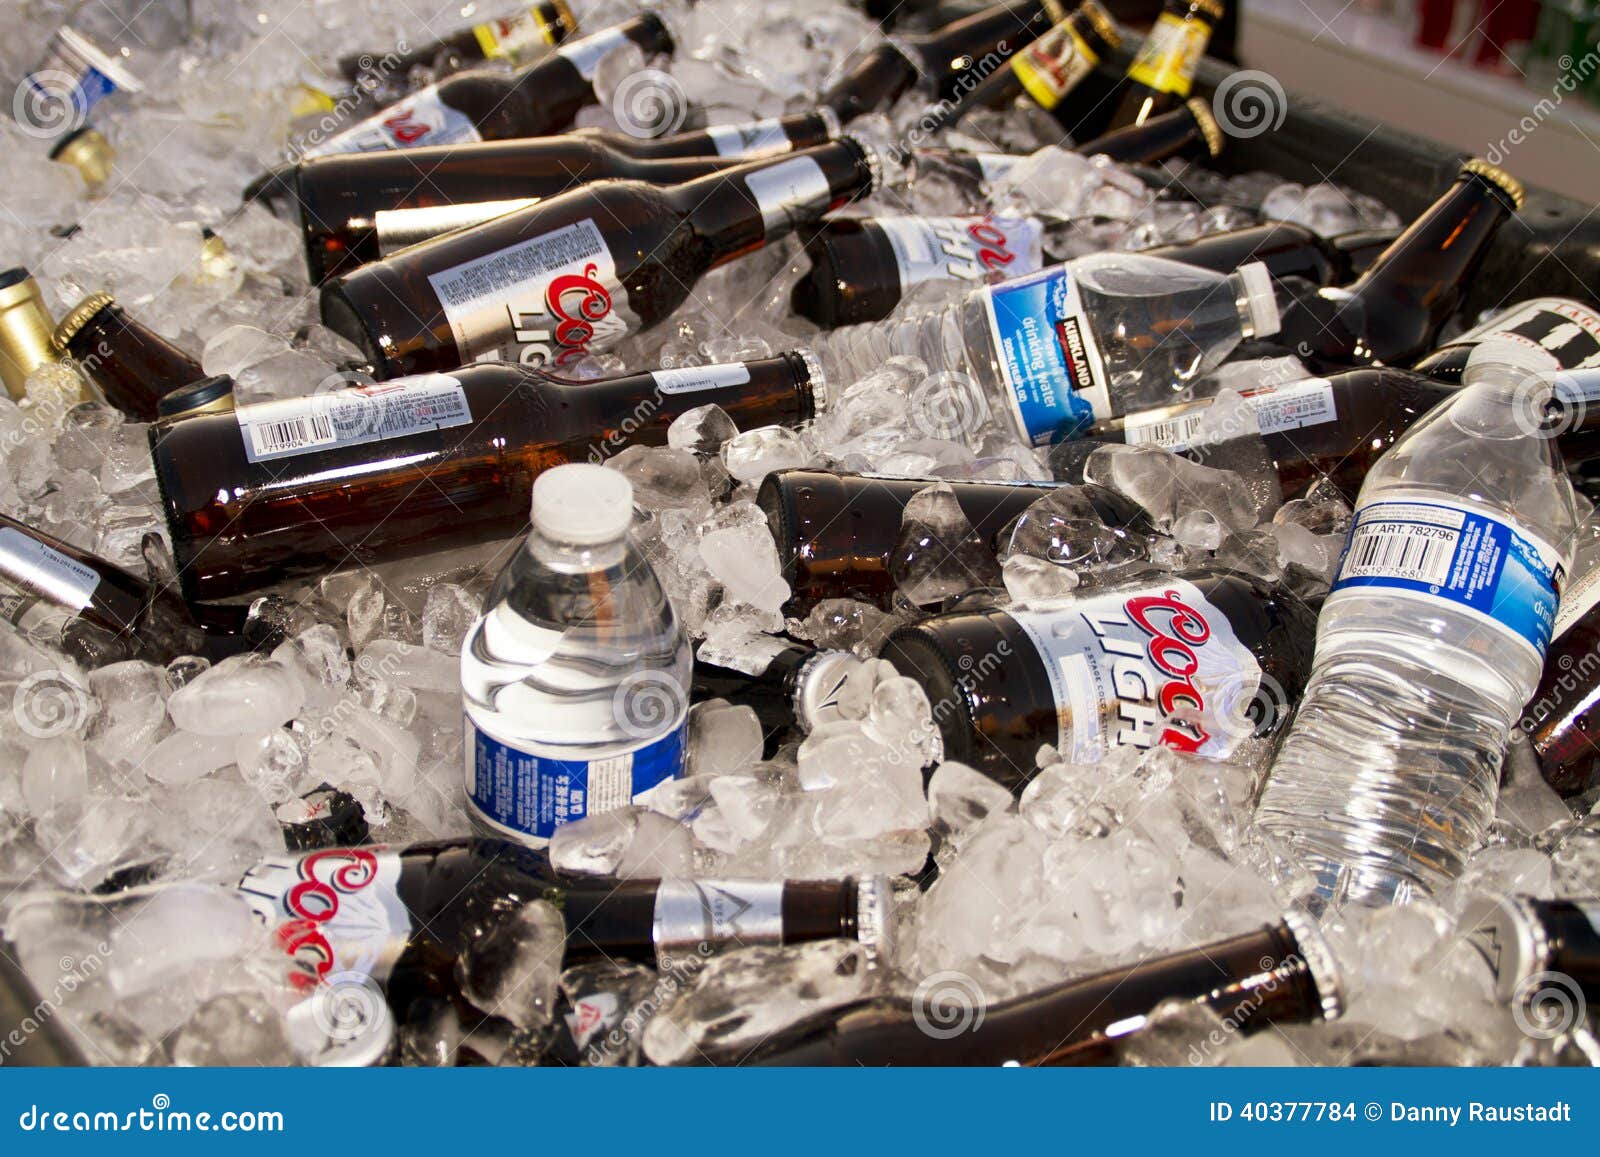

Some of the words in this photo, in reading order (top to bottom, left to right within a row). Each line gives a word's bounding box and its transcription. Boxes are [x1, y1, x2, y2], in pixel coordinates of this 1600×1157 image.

[506, 303, 553, 368] LIG
[1022, 316, 1046, 371] drinking
[1037, 371, 1056, 408] water
[1064, 319, 1092, 387] KIRKLAND
[268, 441, 304, 453] 719904
[1379, 524, 1405, 535] ART.
[1408, 525, 1454, 542] 782796
[1080, 610, 1158, 751] LIGH
[1087, 654, 1102, 683] STAGE
[1097, 685, 1108, 710] COLD
[1122, 589, 1212, 753] Coor
